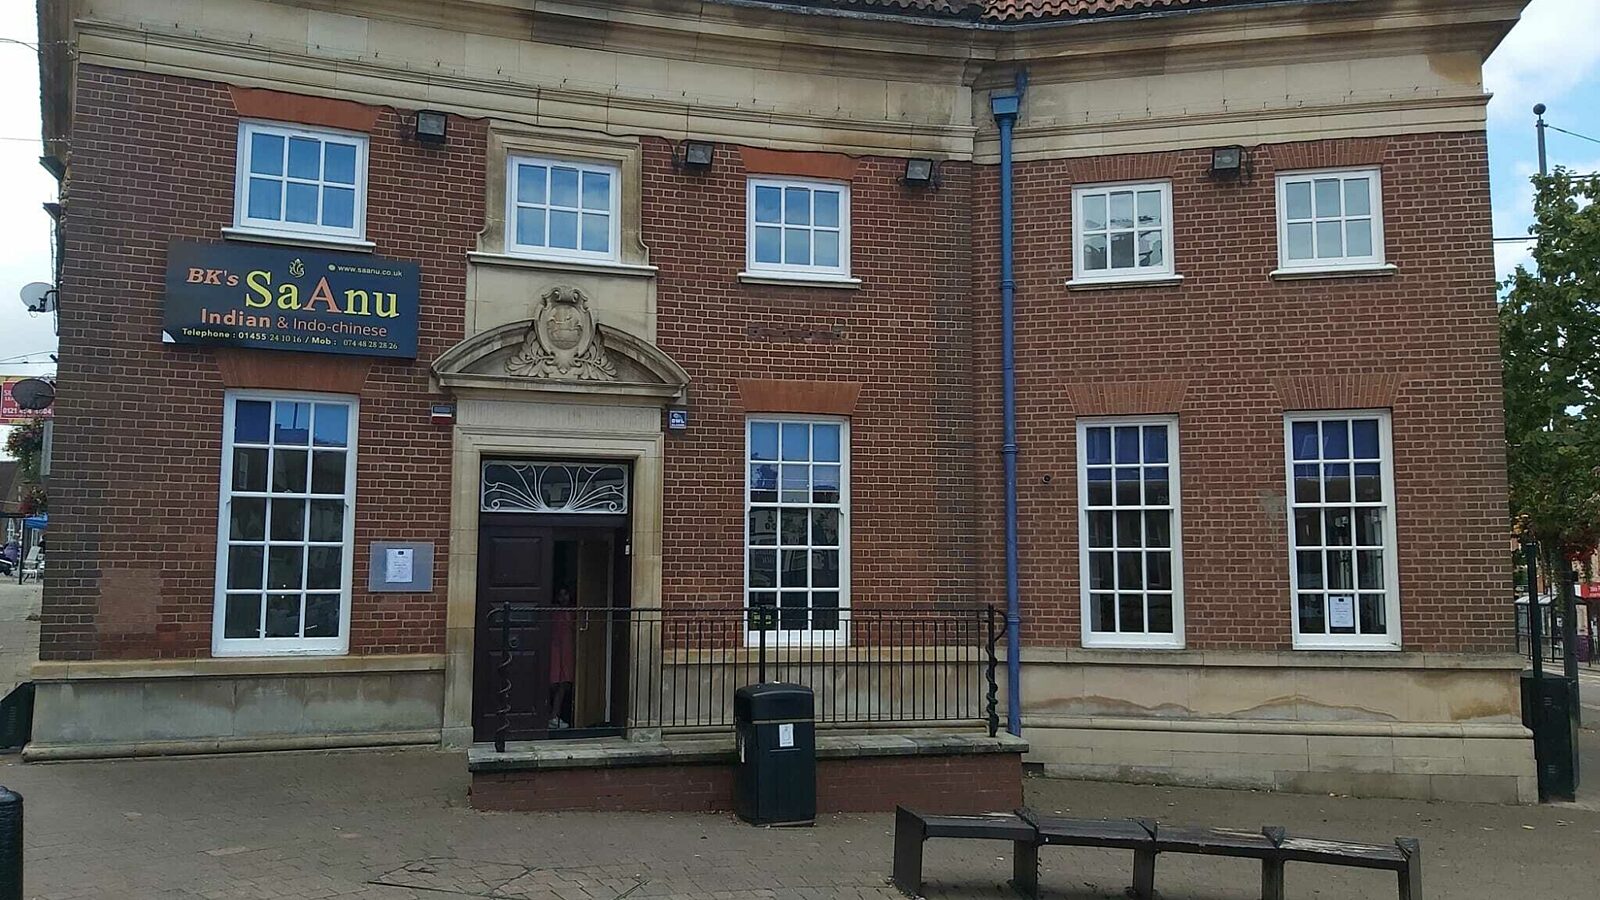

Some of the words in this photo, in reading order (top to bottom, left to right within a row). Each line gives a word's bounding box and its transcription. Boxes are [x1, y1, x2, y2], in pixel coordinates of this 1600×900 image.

[337, 265, 403, 278] www.saanu.co.uk
[186, 267, 239, 286] BK's
[245, 270, 401, 319] SaAnu
[200, 308, 271, 328] Indian
[276, 316, 289, 329] &
[293, 318, 388, 337] Indo-chinese
[181, 327, 230, 338] Telephone
[238, 331, 267, 341] 01455
[293, 335, 302, 343] 16
